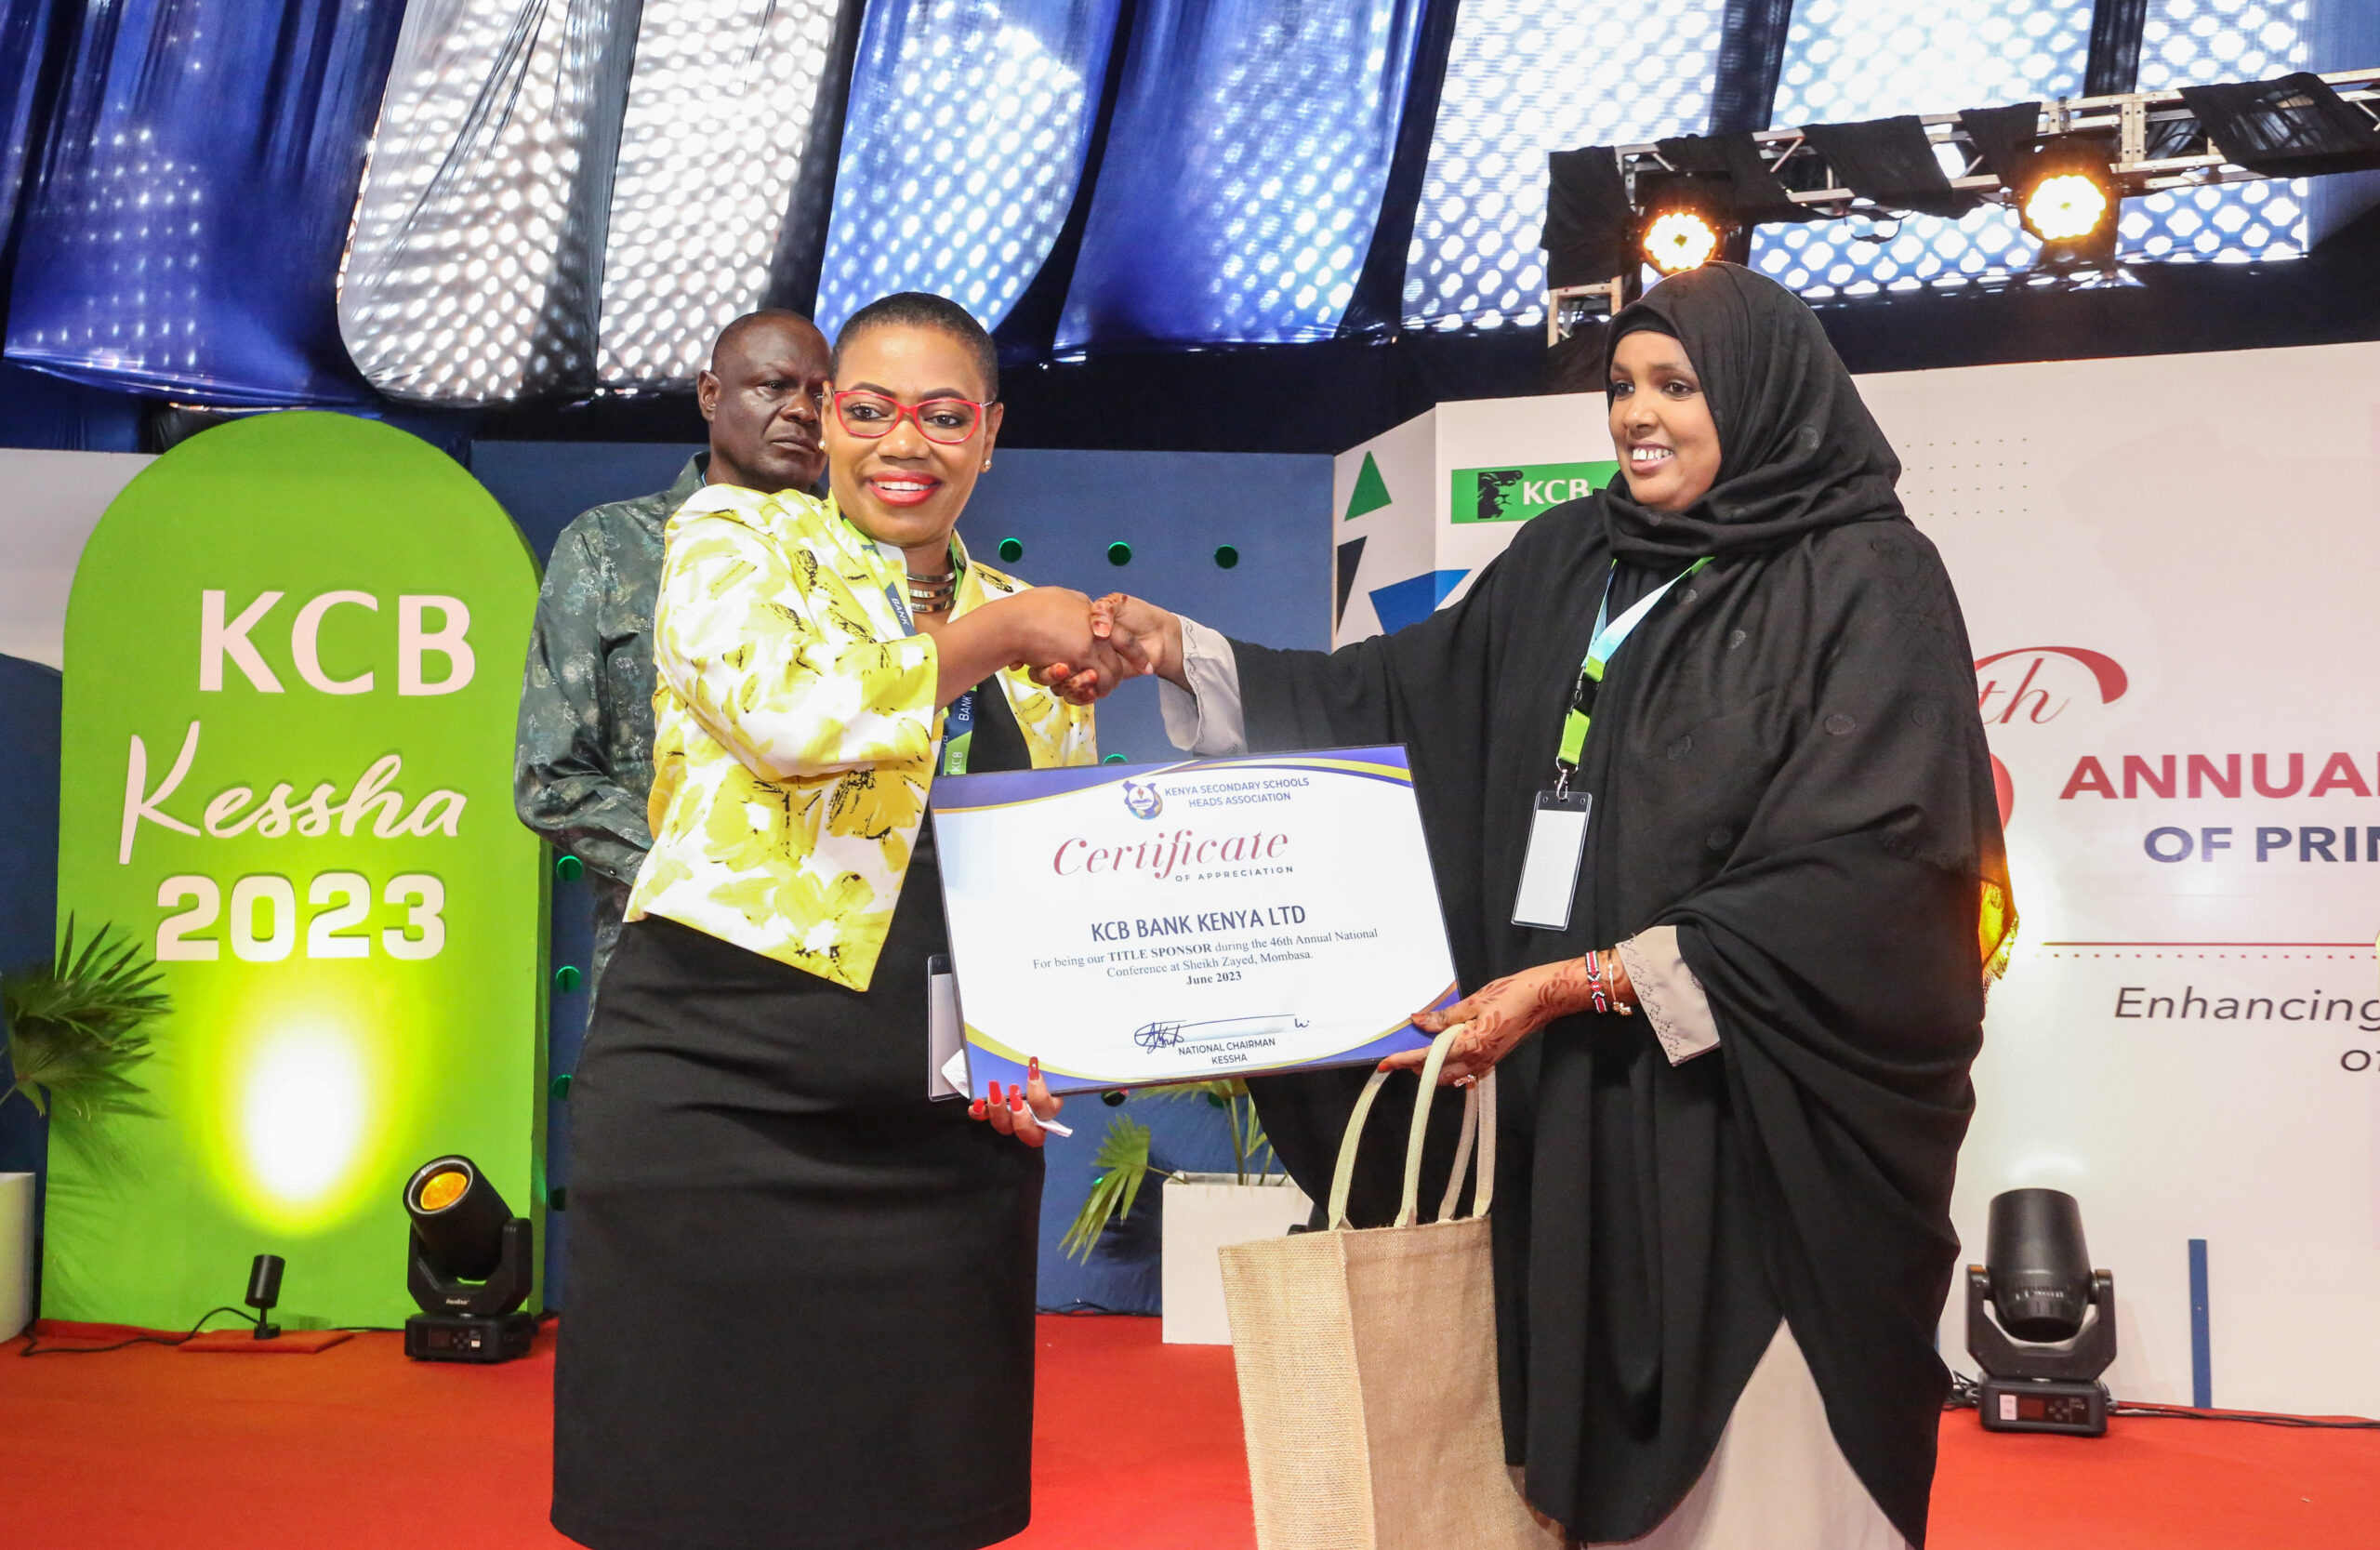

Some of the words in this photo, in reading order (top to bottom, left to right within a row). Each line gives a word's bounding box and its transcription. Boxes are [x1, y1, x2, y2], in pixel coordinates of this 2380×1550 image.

[1523, 478, 1590, 506] KCB
[891, 597, 910, 626] BANK
[199, 590, 476, 696] KCB
[958, 695, 972, 722] BANK
[951, 751, 963, 773] KCB
[2058, 751, 2380, 800] ANNUA
[119, 721, 467, 865] Kessha
[1165, 787, 1198, 797] KENYA
[1200, 781, 1262, 795] SECONDARY
[1263, 777, 1310, 790] SCHOOLS
[1188, 795, 1223, 808] HEADS
[1225, 792, 1291, 806] ASSOCIATION
[1053, 828, 1289, 880] Certificate
[2143, 827, 2233, 864] OF
[1175, 873, 1191, 882] OF
[1197, 866, 1294, 881] APPRECIATION
[156, 872, 446, 961] 2023
[1091, 921, 1130, 942] KCB
[1135, 915, 1193, 938] BANK
[1197, 908, 1264, 933] KENYA
[1268, 905, 1306, 926] LTD
[1033, 959, 1051, 970] For
[1054, 956, 1085, 968] being
[1087, 955, 1105, 965] our
[1106, 948, 1148, 962] TITLE
[1150, 943, 1213, 959] SPONSOR
[1215, 939, 1250, 953] during
[1251, 937, 1267, 949] the
[1270, 935, 1293, 947] 46th
[1295, 932, 1332, 946] Annual
[1334, 928, 1378, 942] National
[1106, 965, 1168, 978] Conference
[1170, 962, 1181, 973] at
[1183, 958, 1219, 971] Sheikh
[1222, 954, 1258, 969] Zayed,
[1260, 951, 1314, 964] Mombasa.
[1186, 974, 1213, 986] June
[1216, 971, 1242, 983] 2023
[2113, 986, 2380, 1032] Enhancing
[1178, 1043, 1225, 1056] NATIONAL
[1226, 1038, 1276, 1052] CHAIRMAN
[1211, 1053, 1248, 1065] KESSHA
[2340, 1049, 2380, 1073] o
